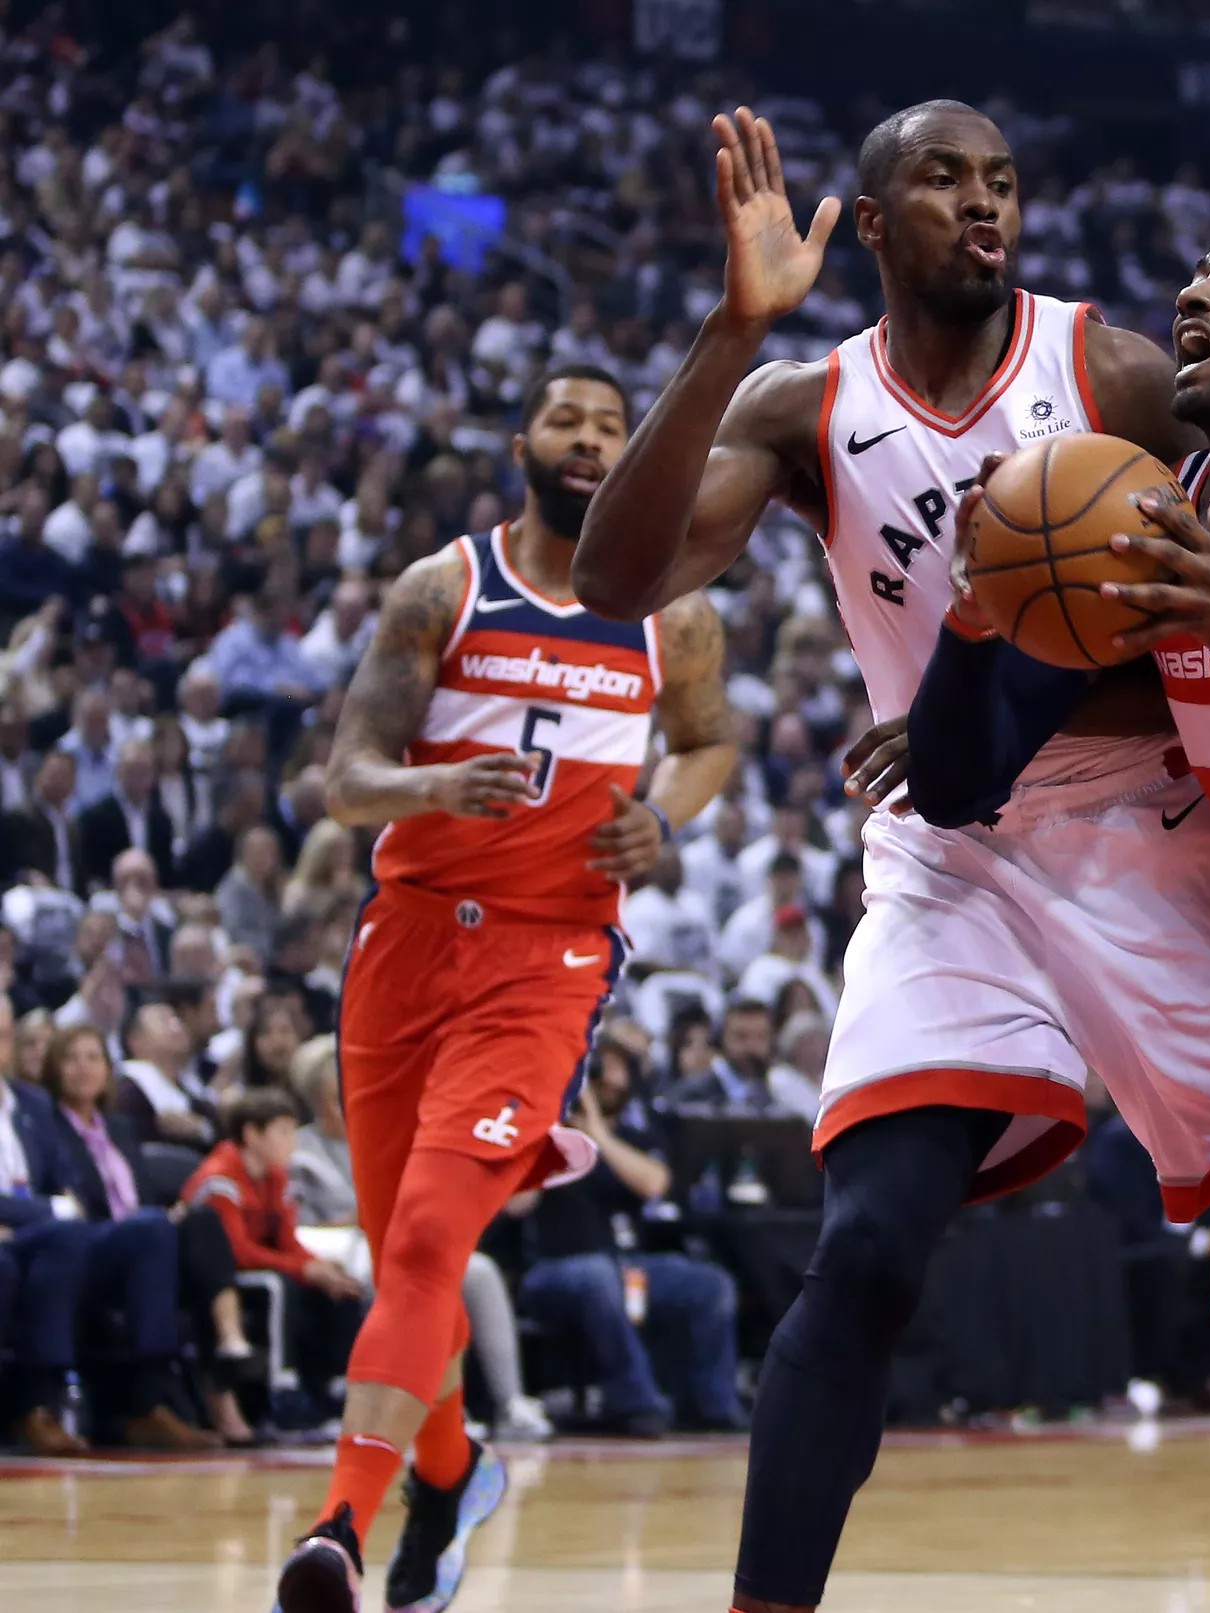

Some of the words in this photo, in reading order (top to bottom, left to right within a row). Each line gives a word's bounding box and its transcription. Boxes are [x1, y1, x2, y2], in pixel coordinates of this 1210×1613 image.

[1019, 429, 1046, 440] Sun
[1047, 418, 1071, 434] Life
[461, 647, 643, 700] washington
[516, 705, 562, 807] 5
